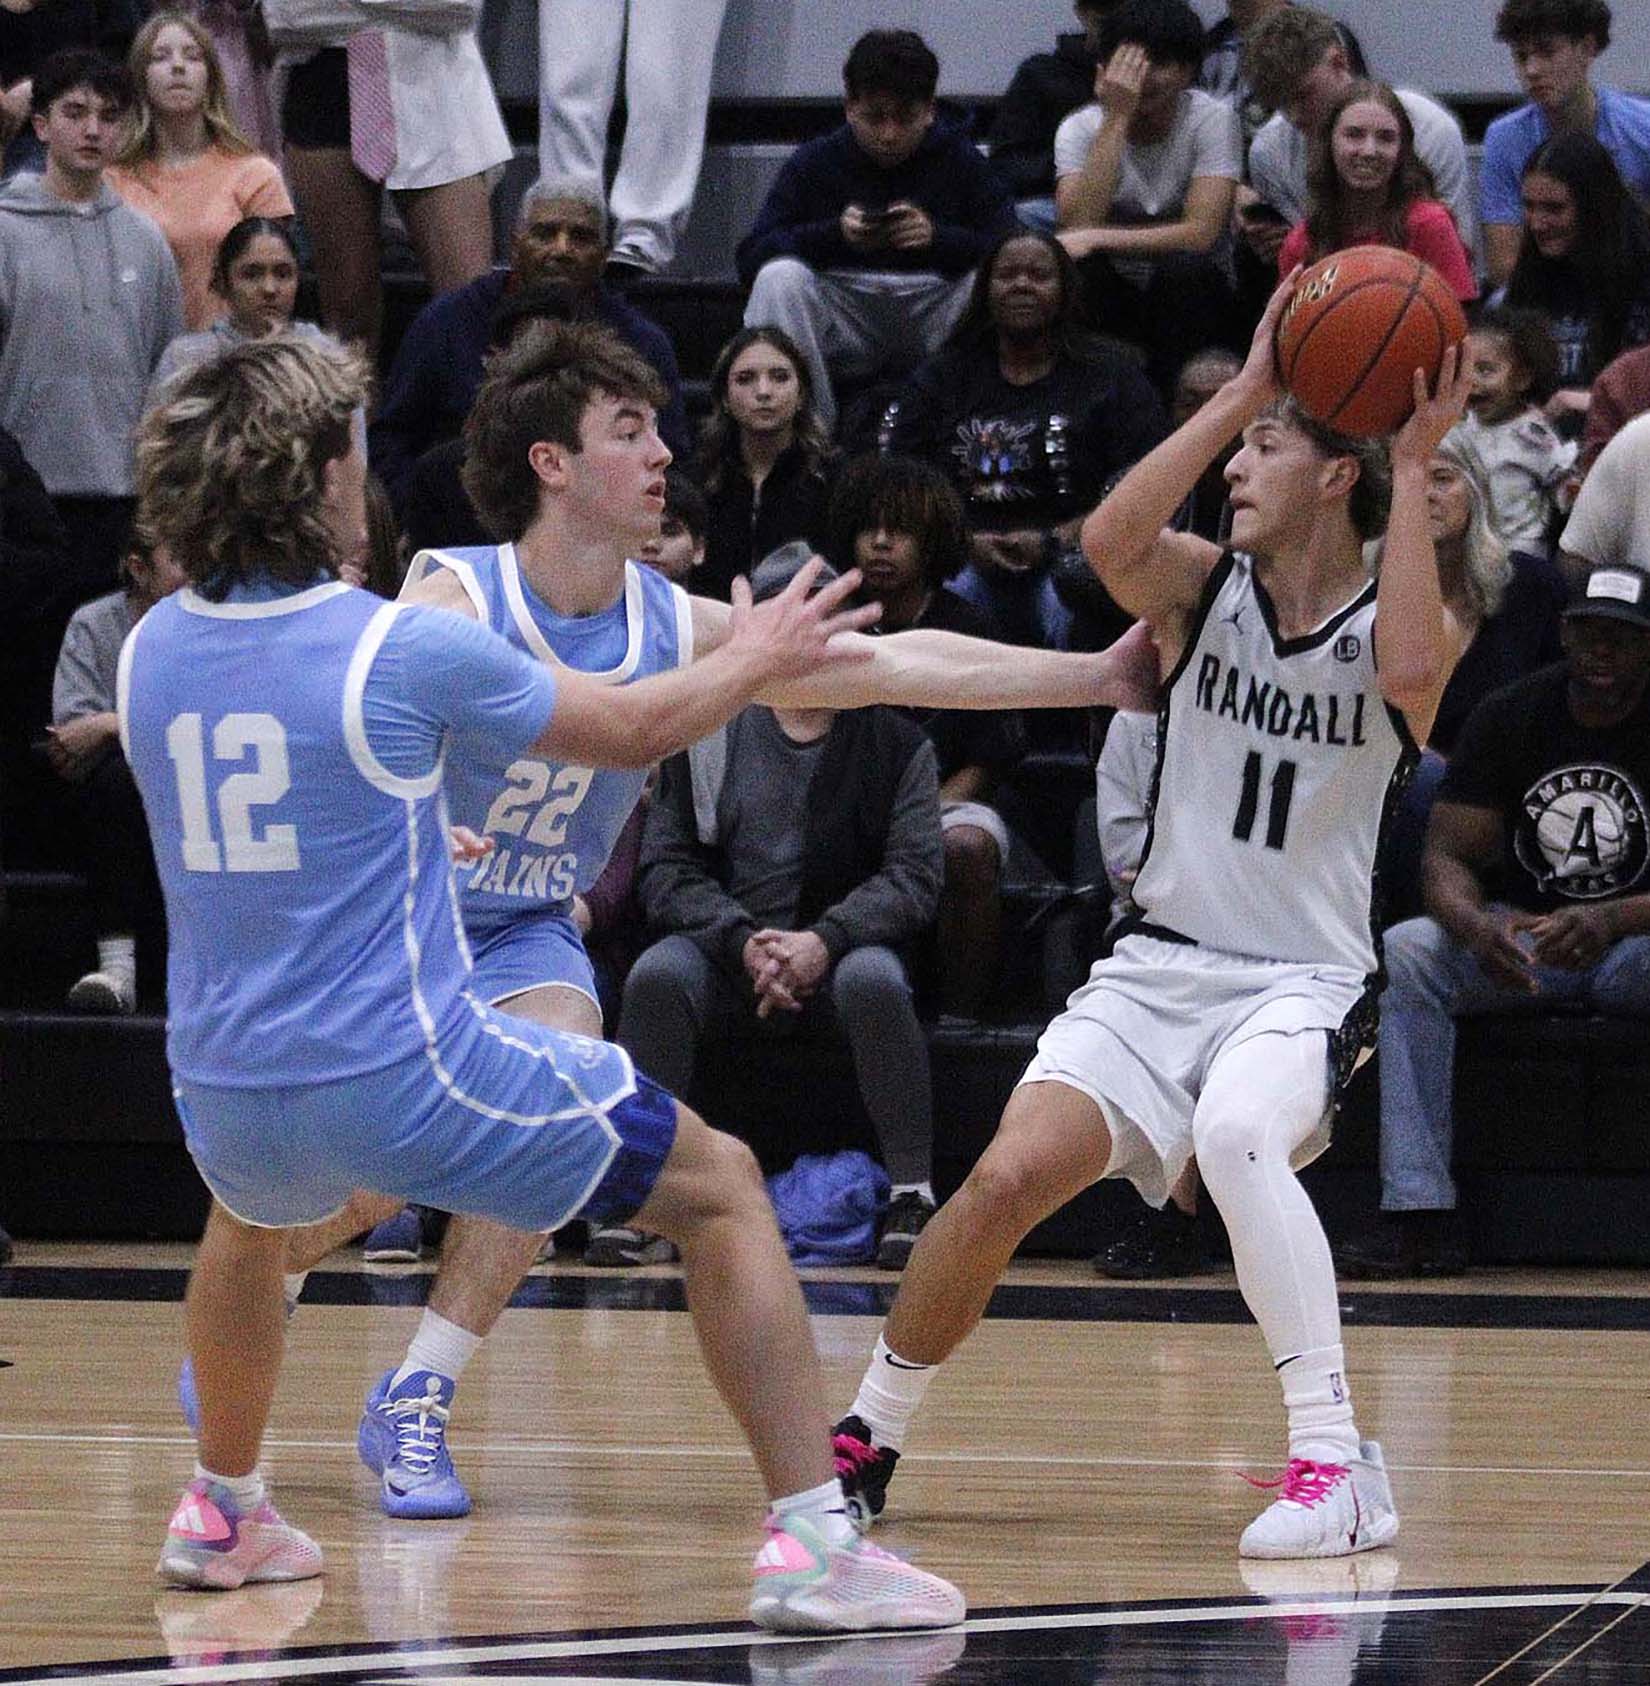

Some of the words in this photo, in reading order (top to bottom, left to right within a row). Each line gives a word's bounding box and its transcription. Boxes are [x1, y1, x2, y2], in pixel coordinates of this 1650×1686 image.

[1335, 638, 1359, 660] LB
[1195, 653, 1367, 747] RANDALL
[166, 712, 301, 873] 12
[483, 760, 595, 848] 22
[1232, 750, 1297, 851] 11
[1563, 806, 1601, 868] A
